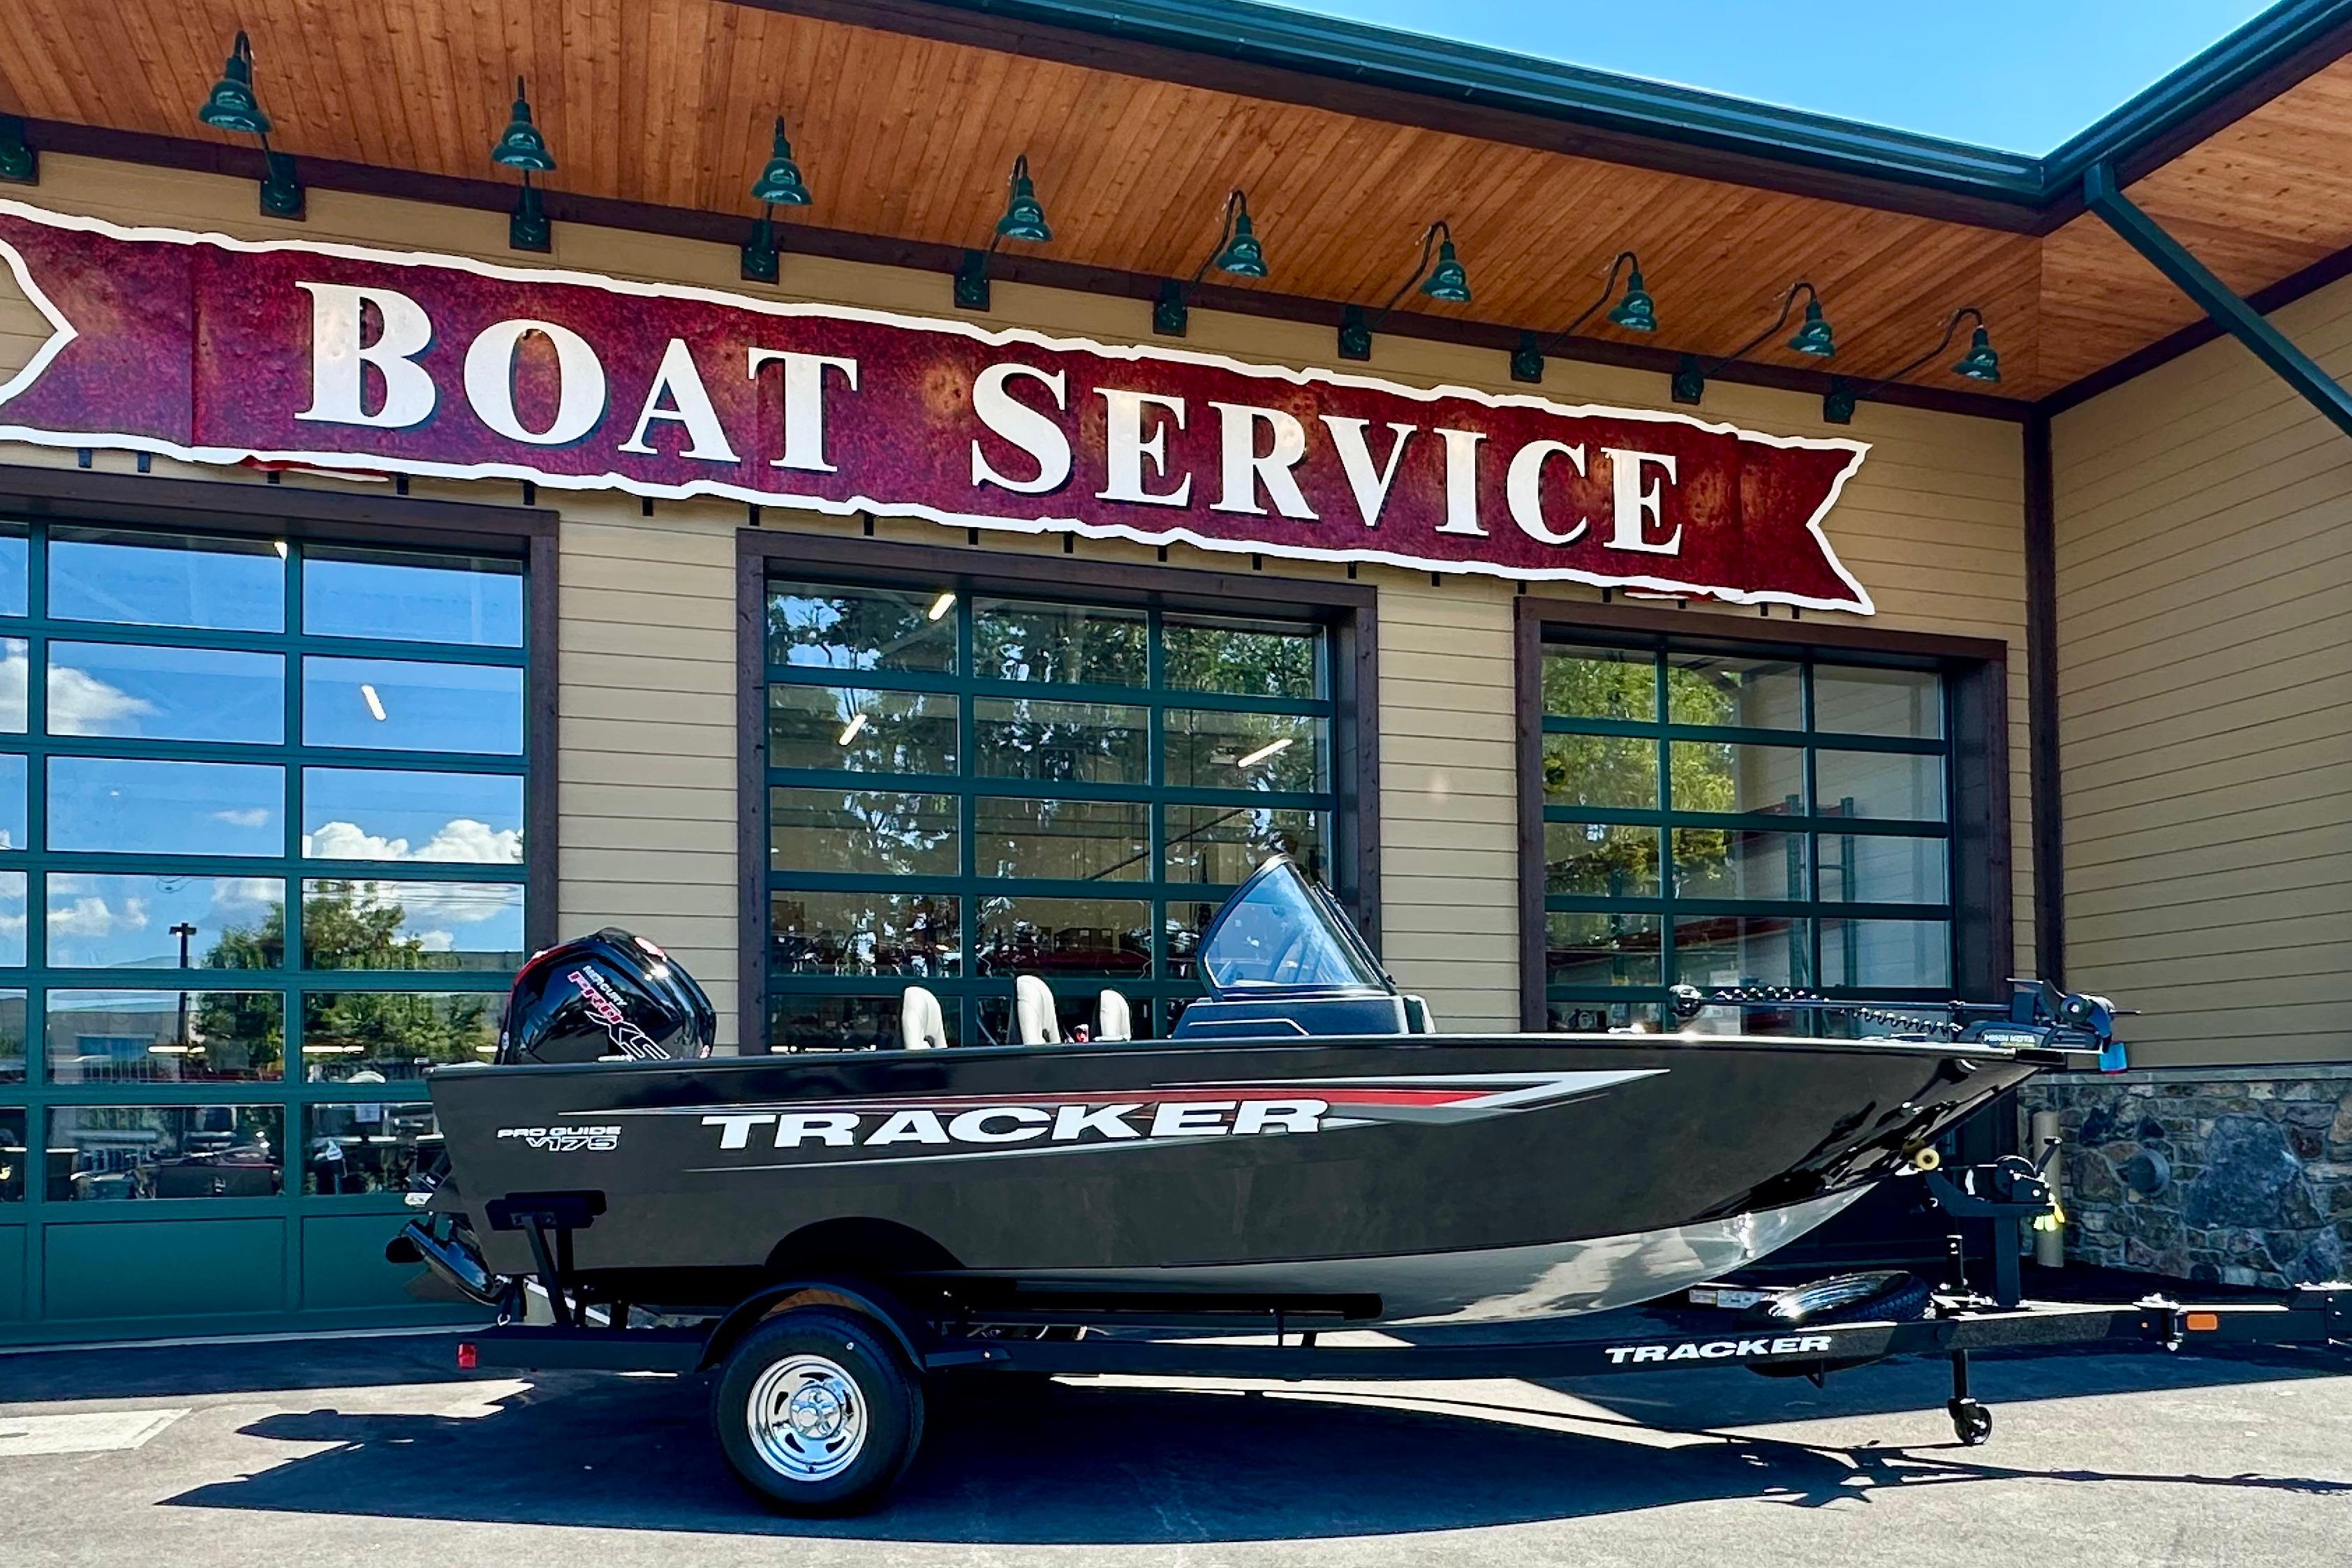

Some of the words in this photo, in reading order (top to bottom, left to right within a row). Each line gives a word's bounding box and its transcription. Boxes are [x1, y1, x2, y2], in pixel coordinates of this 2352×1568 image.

[295, 281, 858, 473] BOAT
[971, 362, 1682, 556] SERVICE
[567, 970, 624, 1025] PRO
[582, 965, 628, 1005] MERCURY
[497, 1127, 547, 1138] PRO
[549, 1126, 622, 1137] GUIDE
[525, 1134, 619, 1152] V175
[700, 1100, 1329, 1150] TRACKER
[1604, 1336, 1833, 1364] TRACKER
